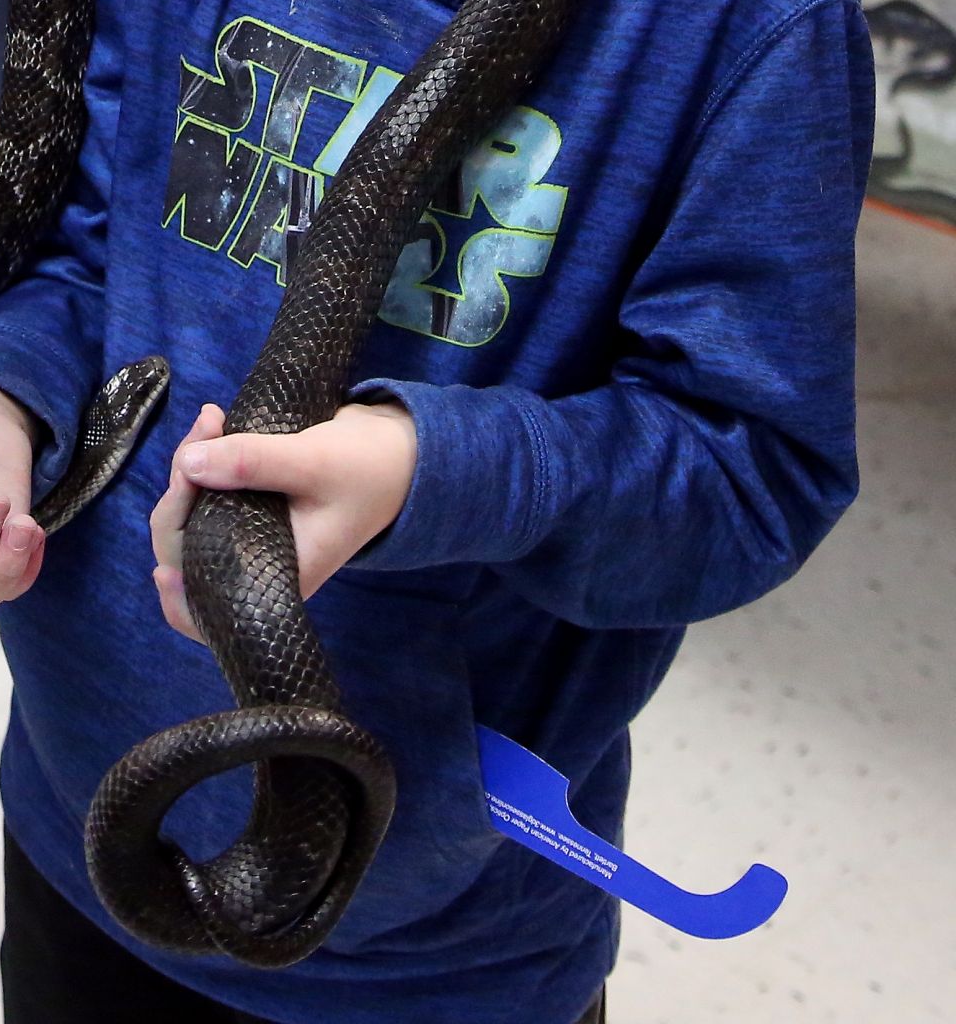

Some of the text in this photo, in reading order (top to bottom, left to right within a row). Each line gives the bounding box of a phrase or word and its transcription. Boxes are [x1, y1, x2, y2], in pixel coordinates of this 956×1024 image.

[510, 817, 531, 833] Paper
[530, 828, 561, 850] American
[560, 844, 570, 856] by
[568, 850, 613, 880] Manufactured
